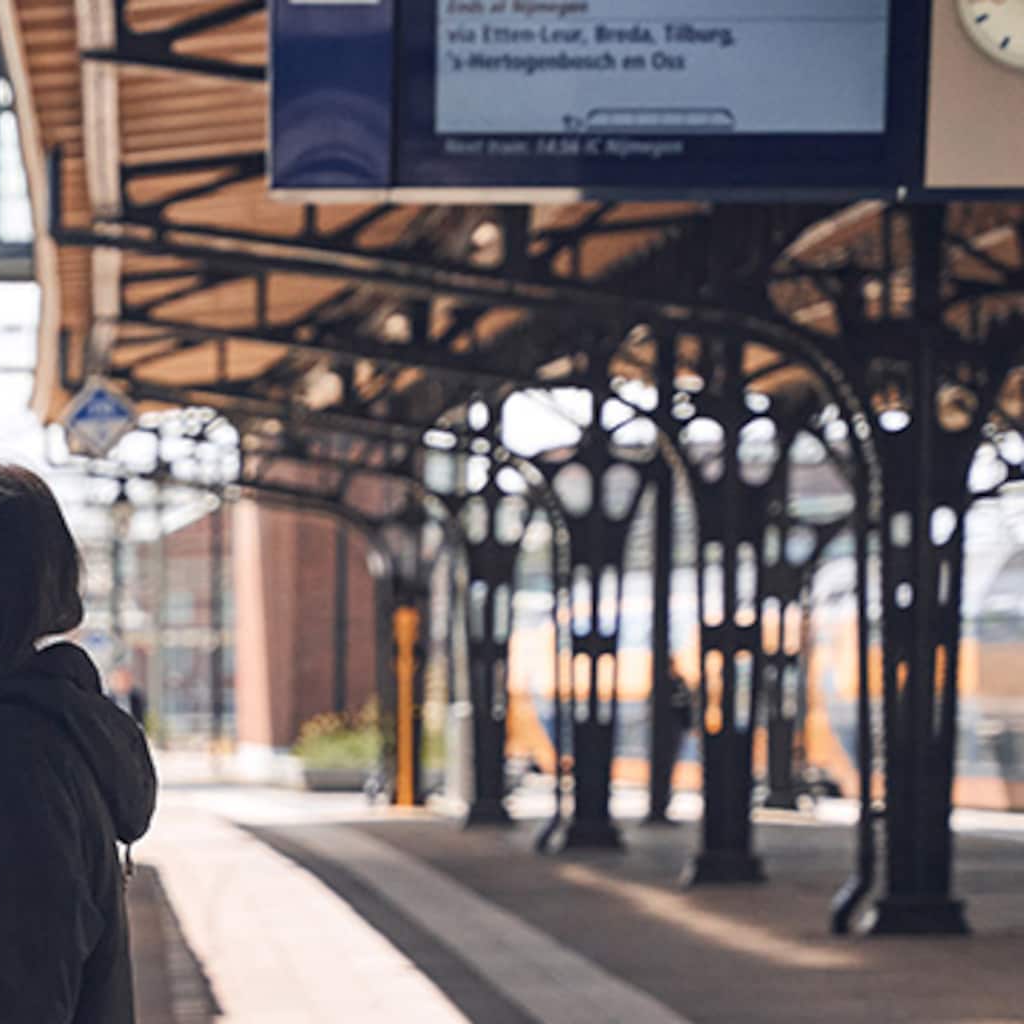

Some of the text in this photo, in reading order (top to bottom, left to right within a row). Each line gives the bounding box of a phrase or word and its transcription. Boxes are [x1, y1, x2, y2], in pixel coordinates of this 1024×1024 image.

[448, 24, 738, 49] via Etten-Leur, Breda, Tilburg,
[622, 56, 647, 71] en
[651, 52, 687, 72] Oss
